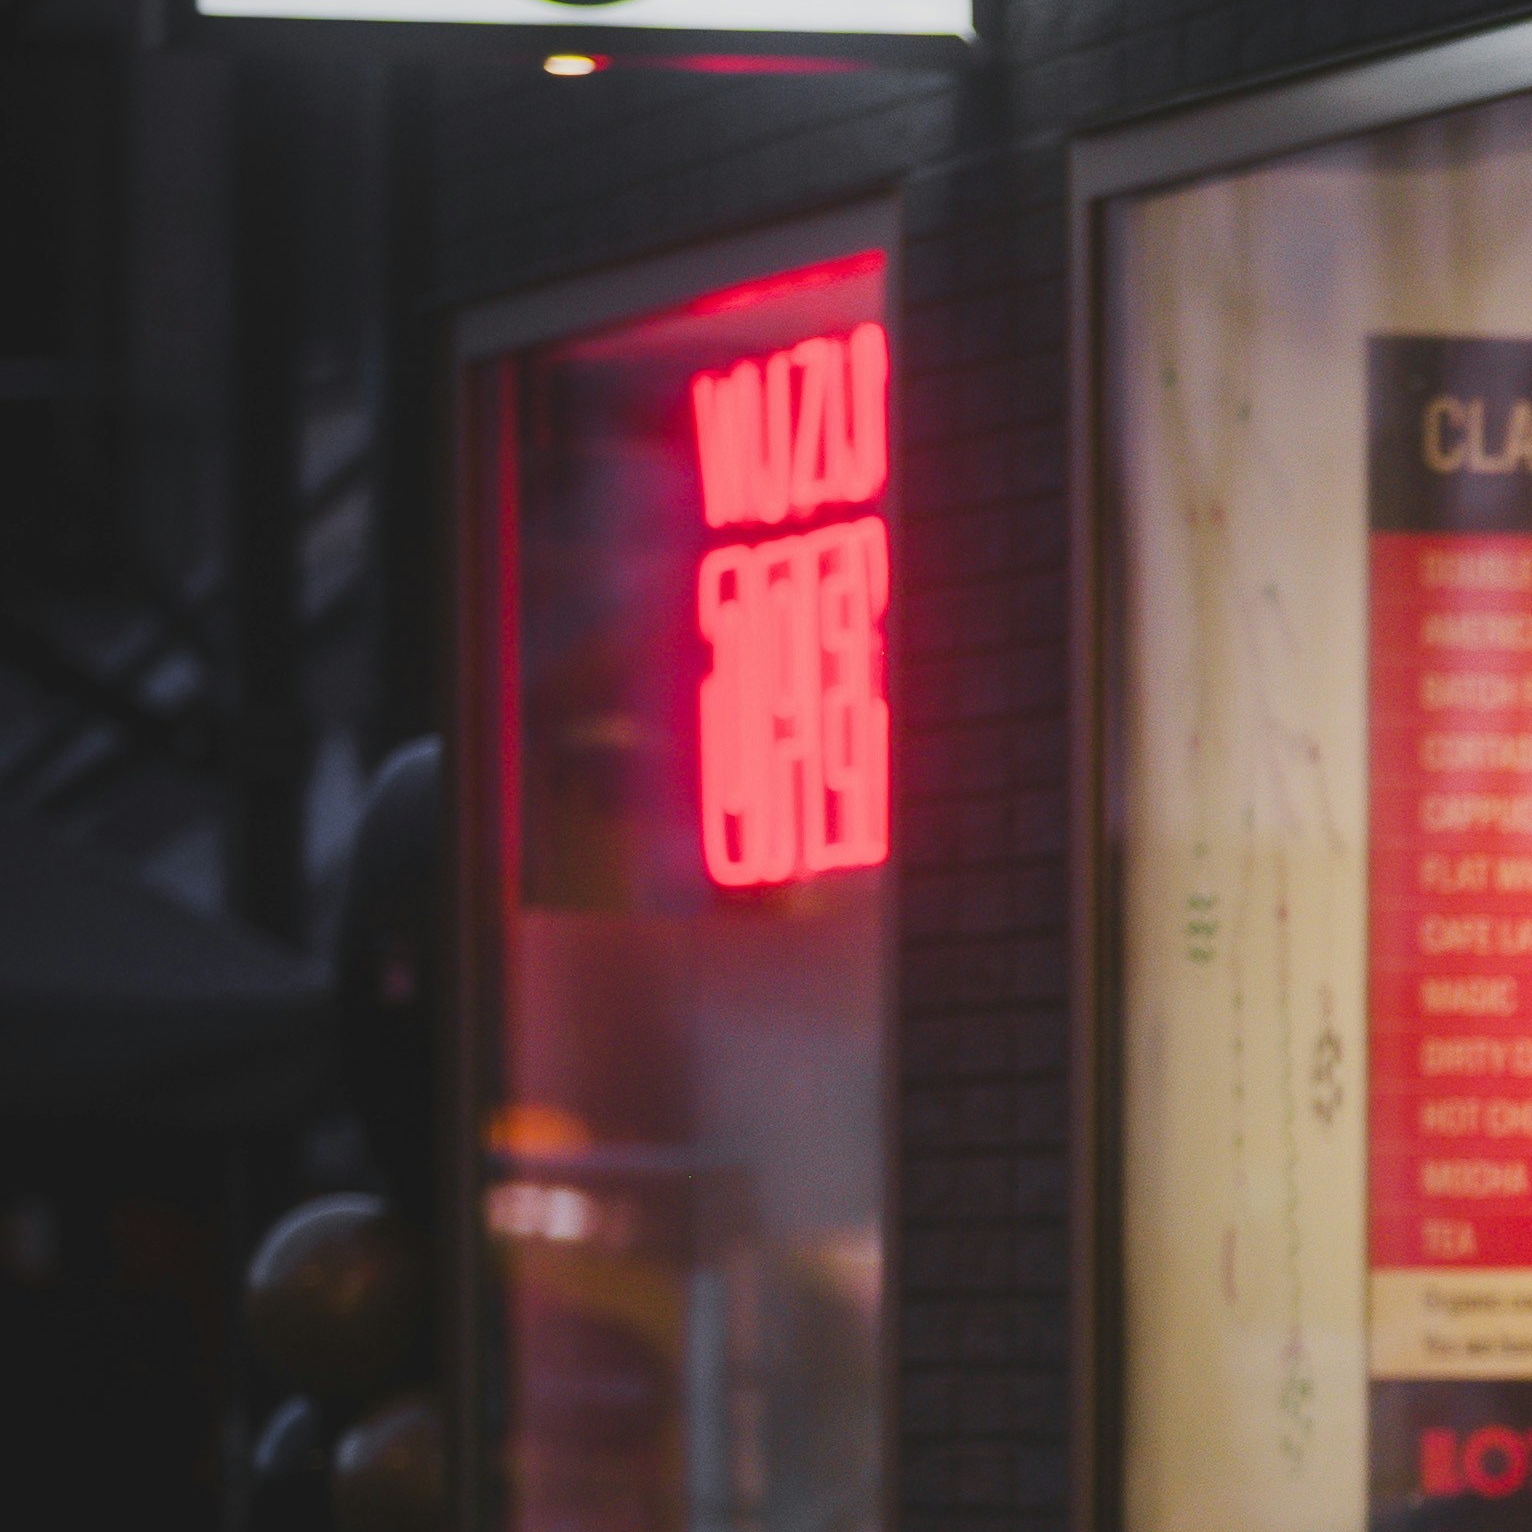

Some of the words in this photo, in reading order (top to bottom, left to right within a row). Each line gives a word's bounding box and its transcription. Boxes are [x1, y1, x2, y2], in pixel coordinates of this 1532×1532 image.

[1420, 853, 1489, 895] FLAT
[1420, 1035, 1507, 1077] DIRTY
[1421, 1096, 1480, 1137] HOT
[1421, 1157, 1531, 1198] MOCHA
[1421, 1218, 1479, 1258] TEA
